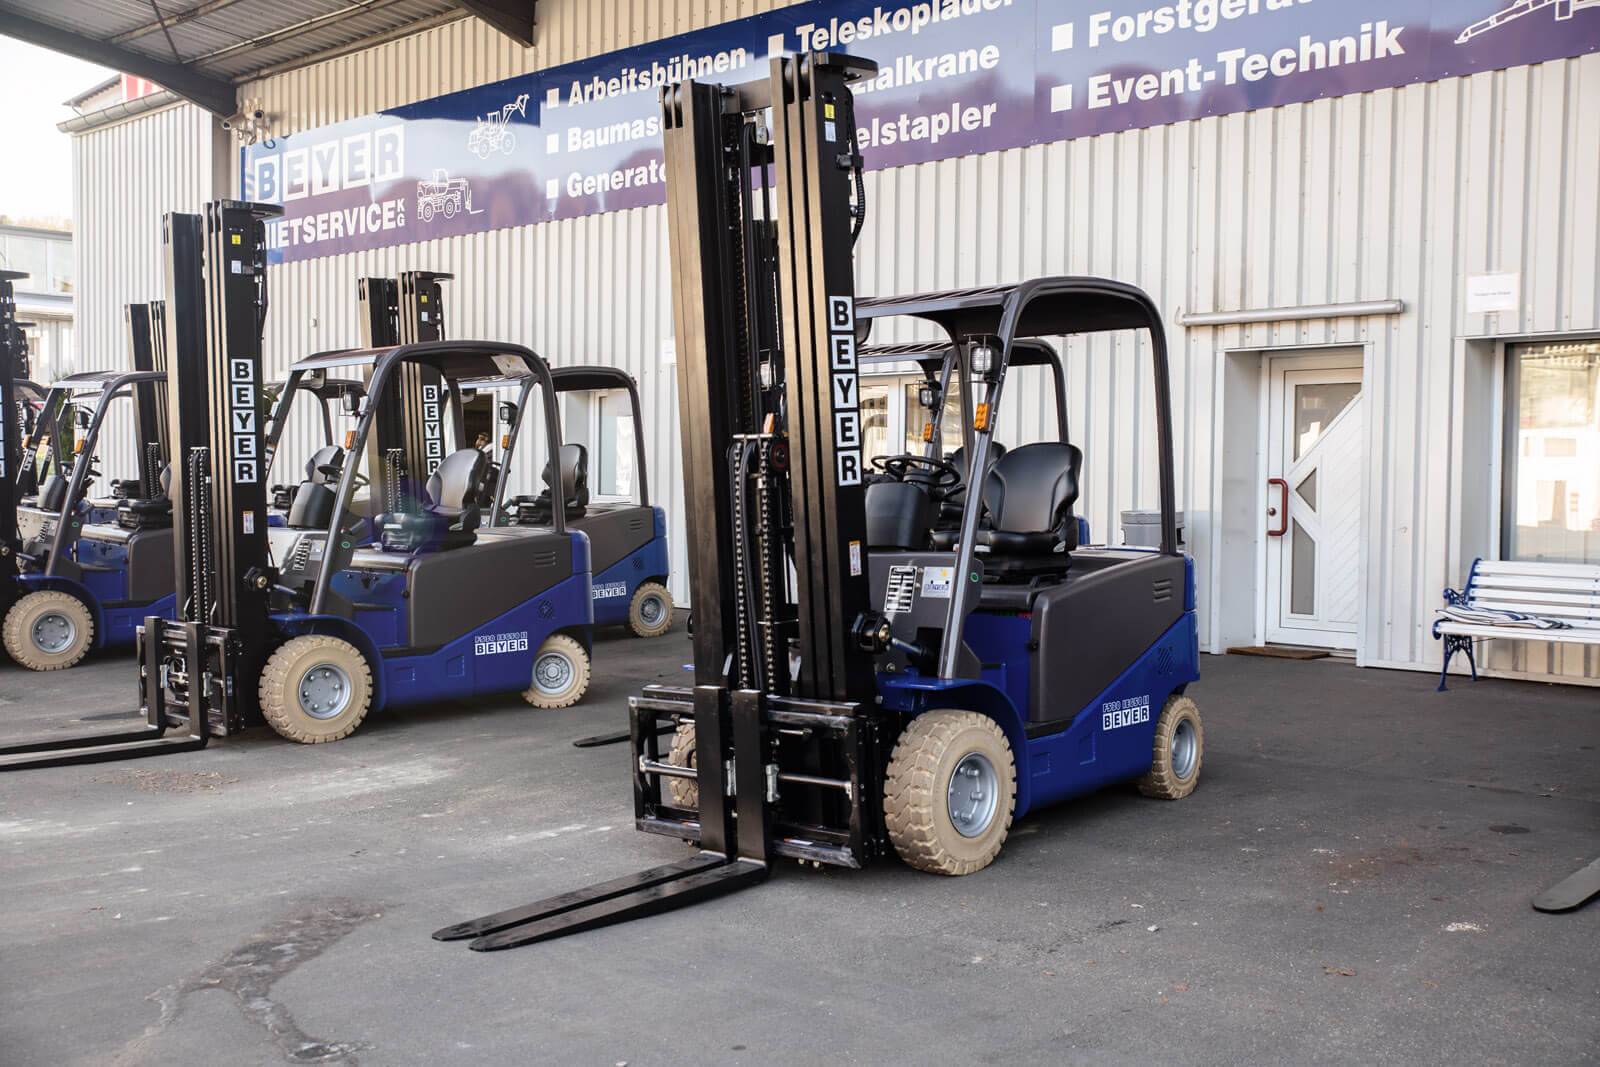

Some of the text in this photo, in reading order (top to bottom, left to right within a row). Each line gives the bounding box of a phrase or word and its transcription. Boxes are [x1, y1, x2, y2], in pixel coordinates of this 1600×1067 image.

[796, 0, 1012, 54] Teleskoplade
[1088, 0, 1312, 47] Forstger
[568, 47, 746, 107] Arbeitsbühnen
[1088, 20, 1404, 109] Event-Technik
[567, 116, 663, 153] Baumas
[856, 102, 997, 150] elstapler
[255, 124, 404, 204] BEYER
[567, 159, 666, 198] Generat
[265, 203, 397, 250] IETSERVICE
[829, 296, 862, 486] BEYER
[231, 359, 257, 483] BEYER
[475, 639, 528, 655] BEYER
[1103, 705, 1149, 730] BEYER
